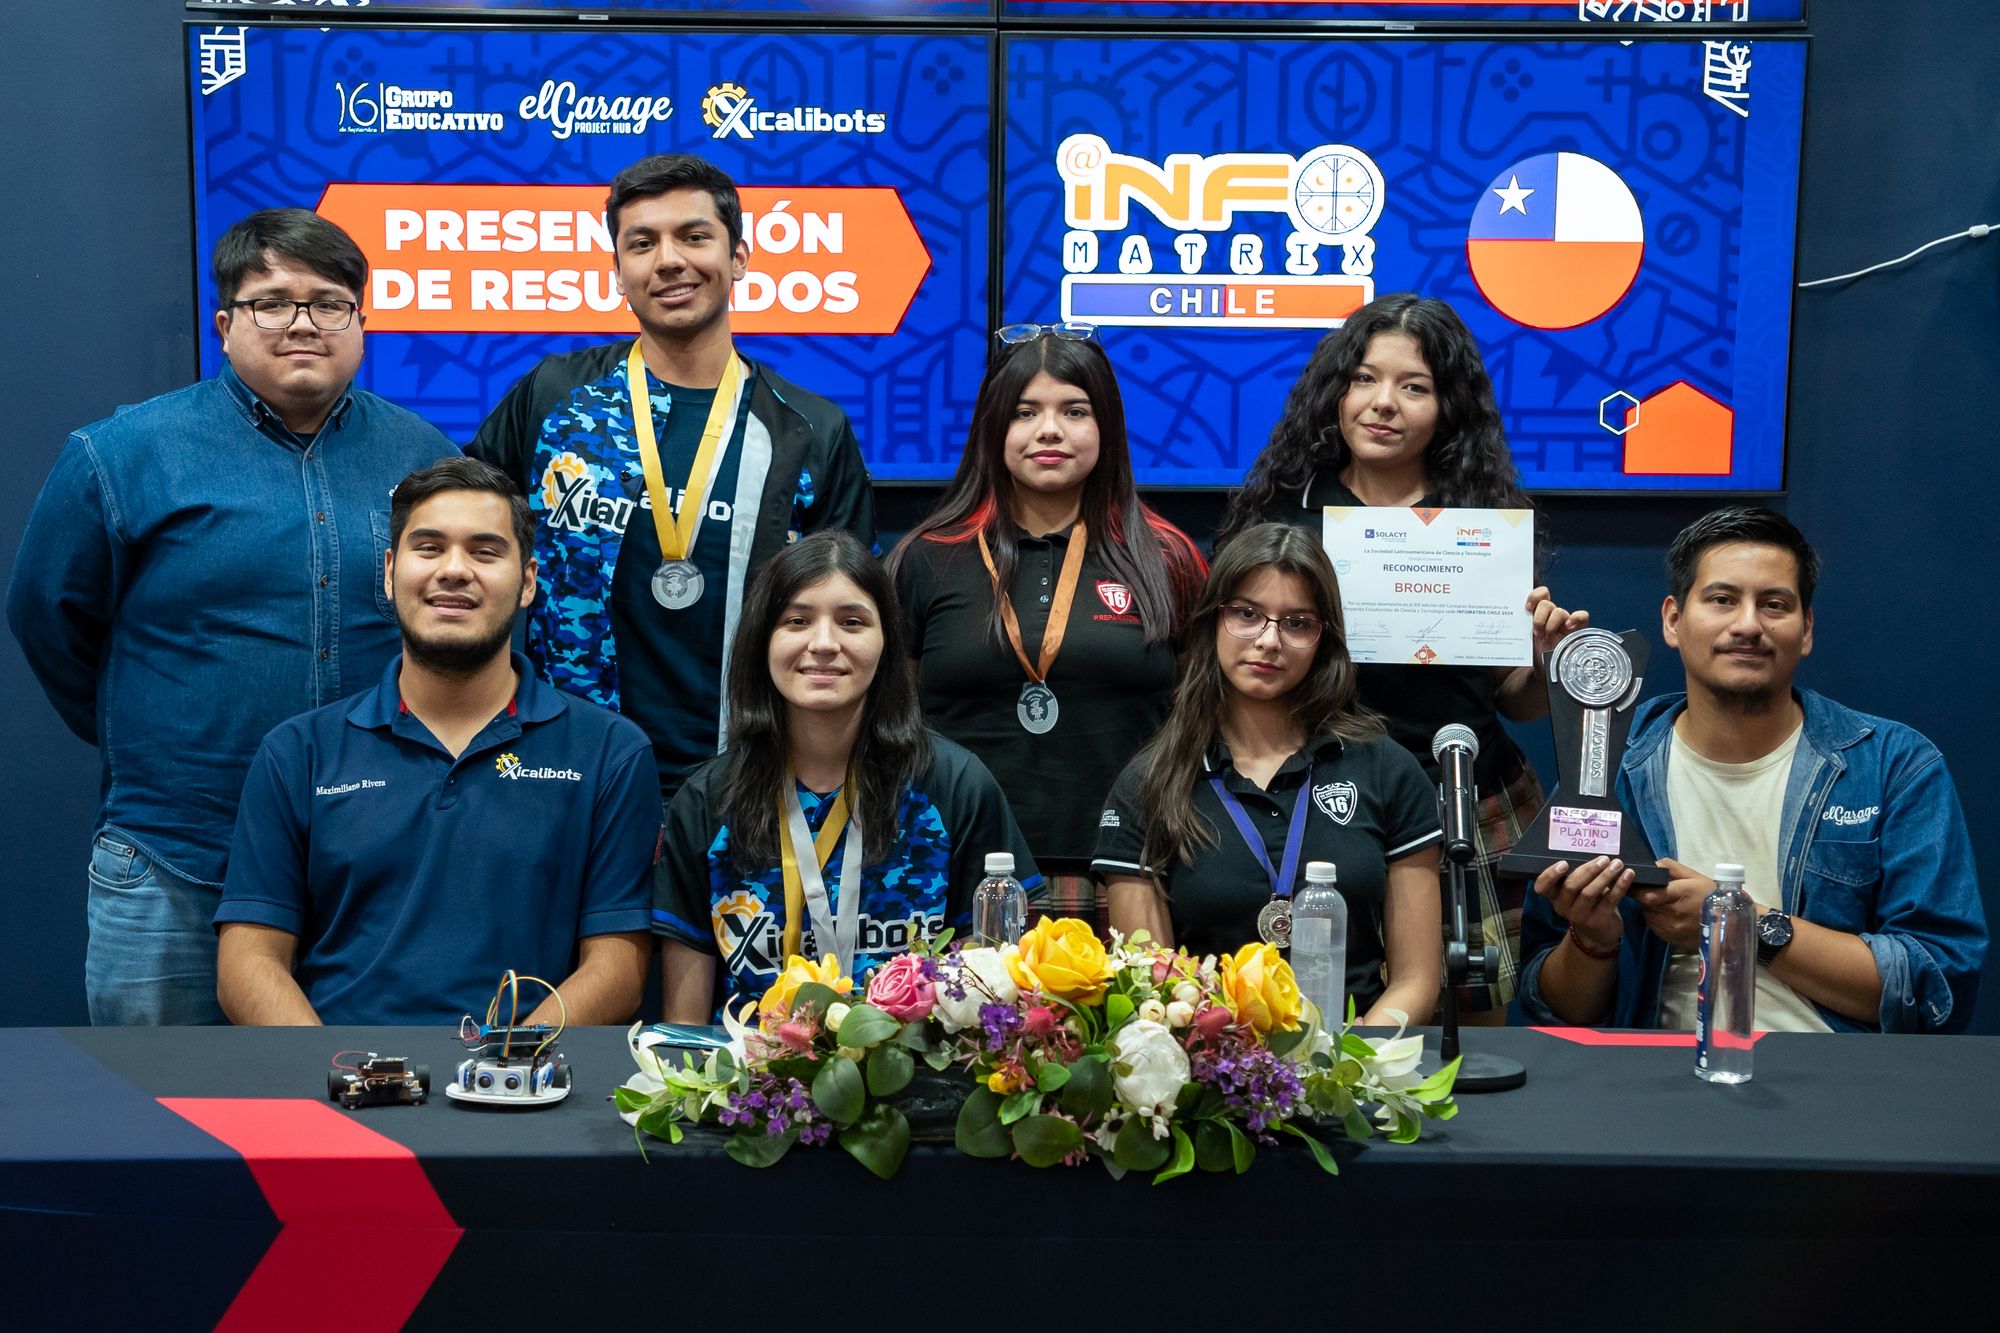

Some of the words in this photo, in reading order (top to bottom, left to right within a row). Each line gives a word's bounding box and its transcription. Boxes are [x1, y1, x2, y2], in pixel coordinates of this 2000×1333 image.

[385, 86, 453, 108] GRUPO
[385, 109, 504, 131] EDUCATIVO
[713, 96, 885, 139] Xicalibots
[575, 122, 611, 134] PROJECT
[613, 122, 631, 134] HUB
[385, 200, 843, 254] PRESENIÓN
[1072, 241, 1366, 266] MATRIX
[372, 269, 452, 309] DE
[471, 269, 860, 313] RESUDOS
[1149, 287, 1275, 315] CHILE
[1383, 564, 1464, 573] RECONOCIMIENTO
[1395, 582, 1451, 594] BRONCE
[1104, 591, 1126, 608] 16
[499, 757, 582, 780] Xicalibots
[361, 779, 386, 788] Rivera
[1325, 796, 1348, 813] 16
[1560, 827, 1609, 838] PLATINO
[1571, 838, 1597, 847] 2024
